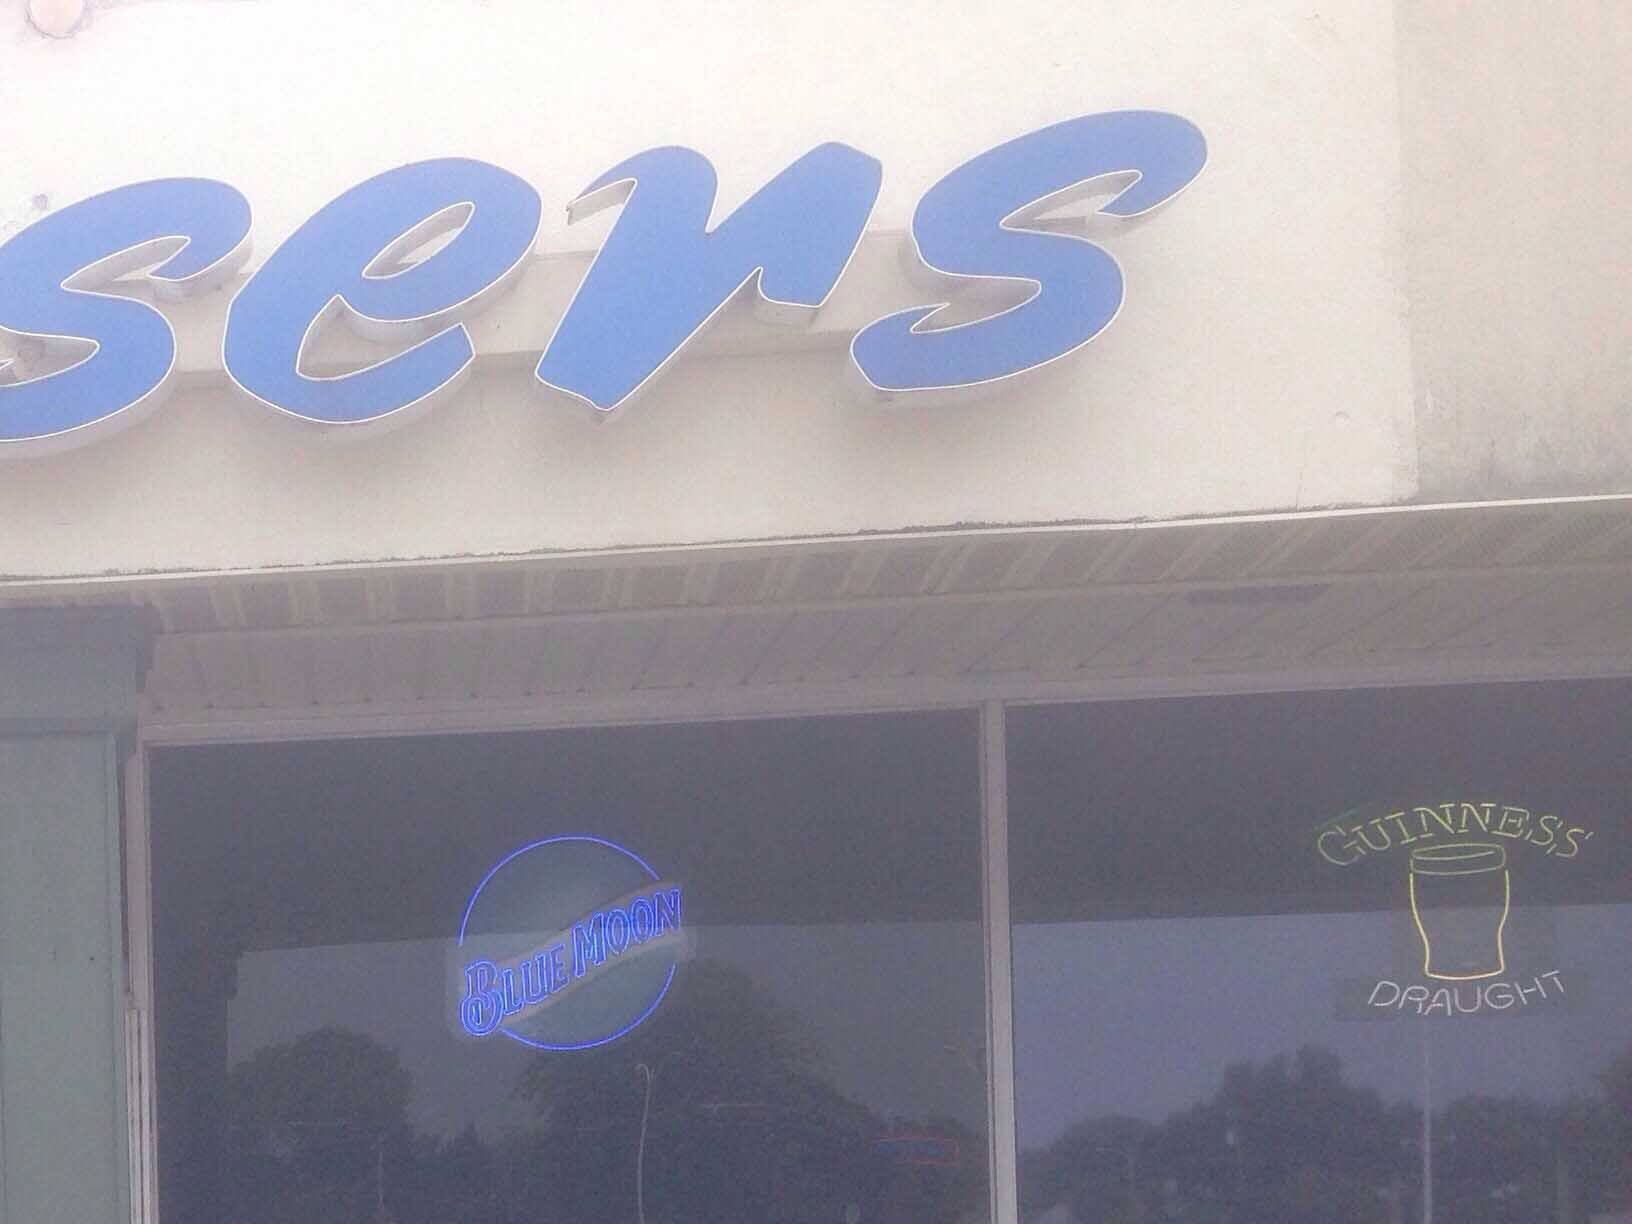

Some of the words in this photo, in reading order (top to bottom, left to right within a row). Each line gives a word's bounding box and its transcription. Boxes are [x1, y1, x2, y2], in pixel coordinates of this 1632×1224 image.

[1317, 802, 1594, 866] GUINNESS
[460, 944, 567, 1036] BLUE
[572, 888, 681, 977] MOON
[1368, 970, 1564, 1016] DRAUGHT
